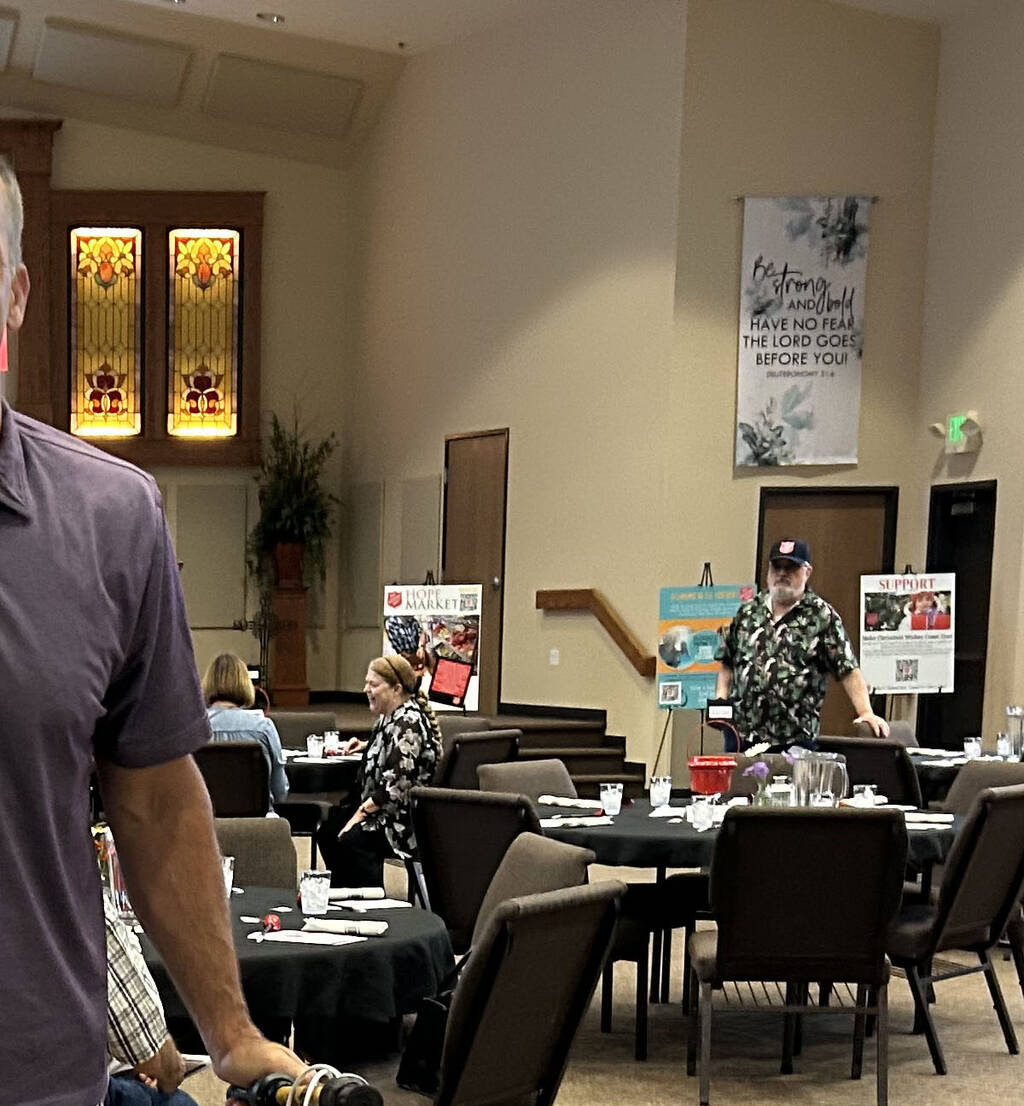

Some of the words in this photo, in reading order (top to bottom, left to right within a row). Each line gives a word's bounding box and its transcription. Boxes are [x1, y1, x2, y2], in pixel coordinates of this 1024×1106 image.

[753, 253, 776, 280] Be
[773, 262, 831, 315] strong
[788, 299, 816, 310] AND
[826, 286, 855, 321] bold
[750, 318, 788, 331] HAVE
[793, 318, 818, 331] NO
[822, 318, 855, 331] FEAR
[743, 335, 767, 349] THE
[773, 334, 812, 348] LORD
[816, 334, 856, 348] GOES
[756, 352, 807, 366] BEFORE
[813, 352, 848, 366] YOU!
[879, 578, 937, 590] SUPPORT
[405, 599, 457, 610] MARKET
